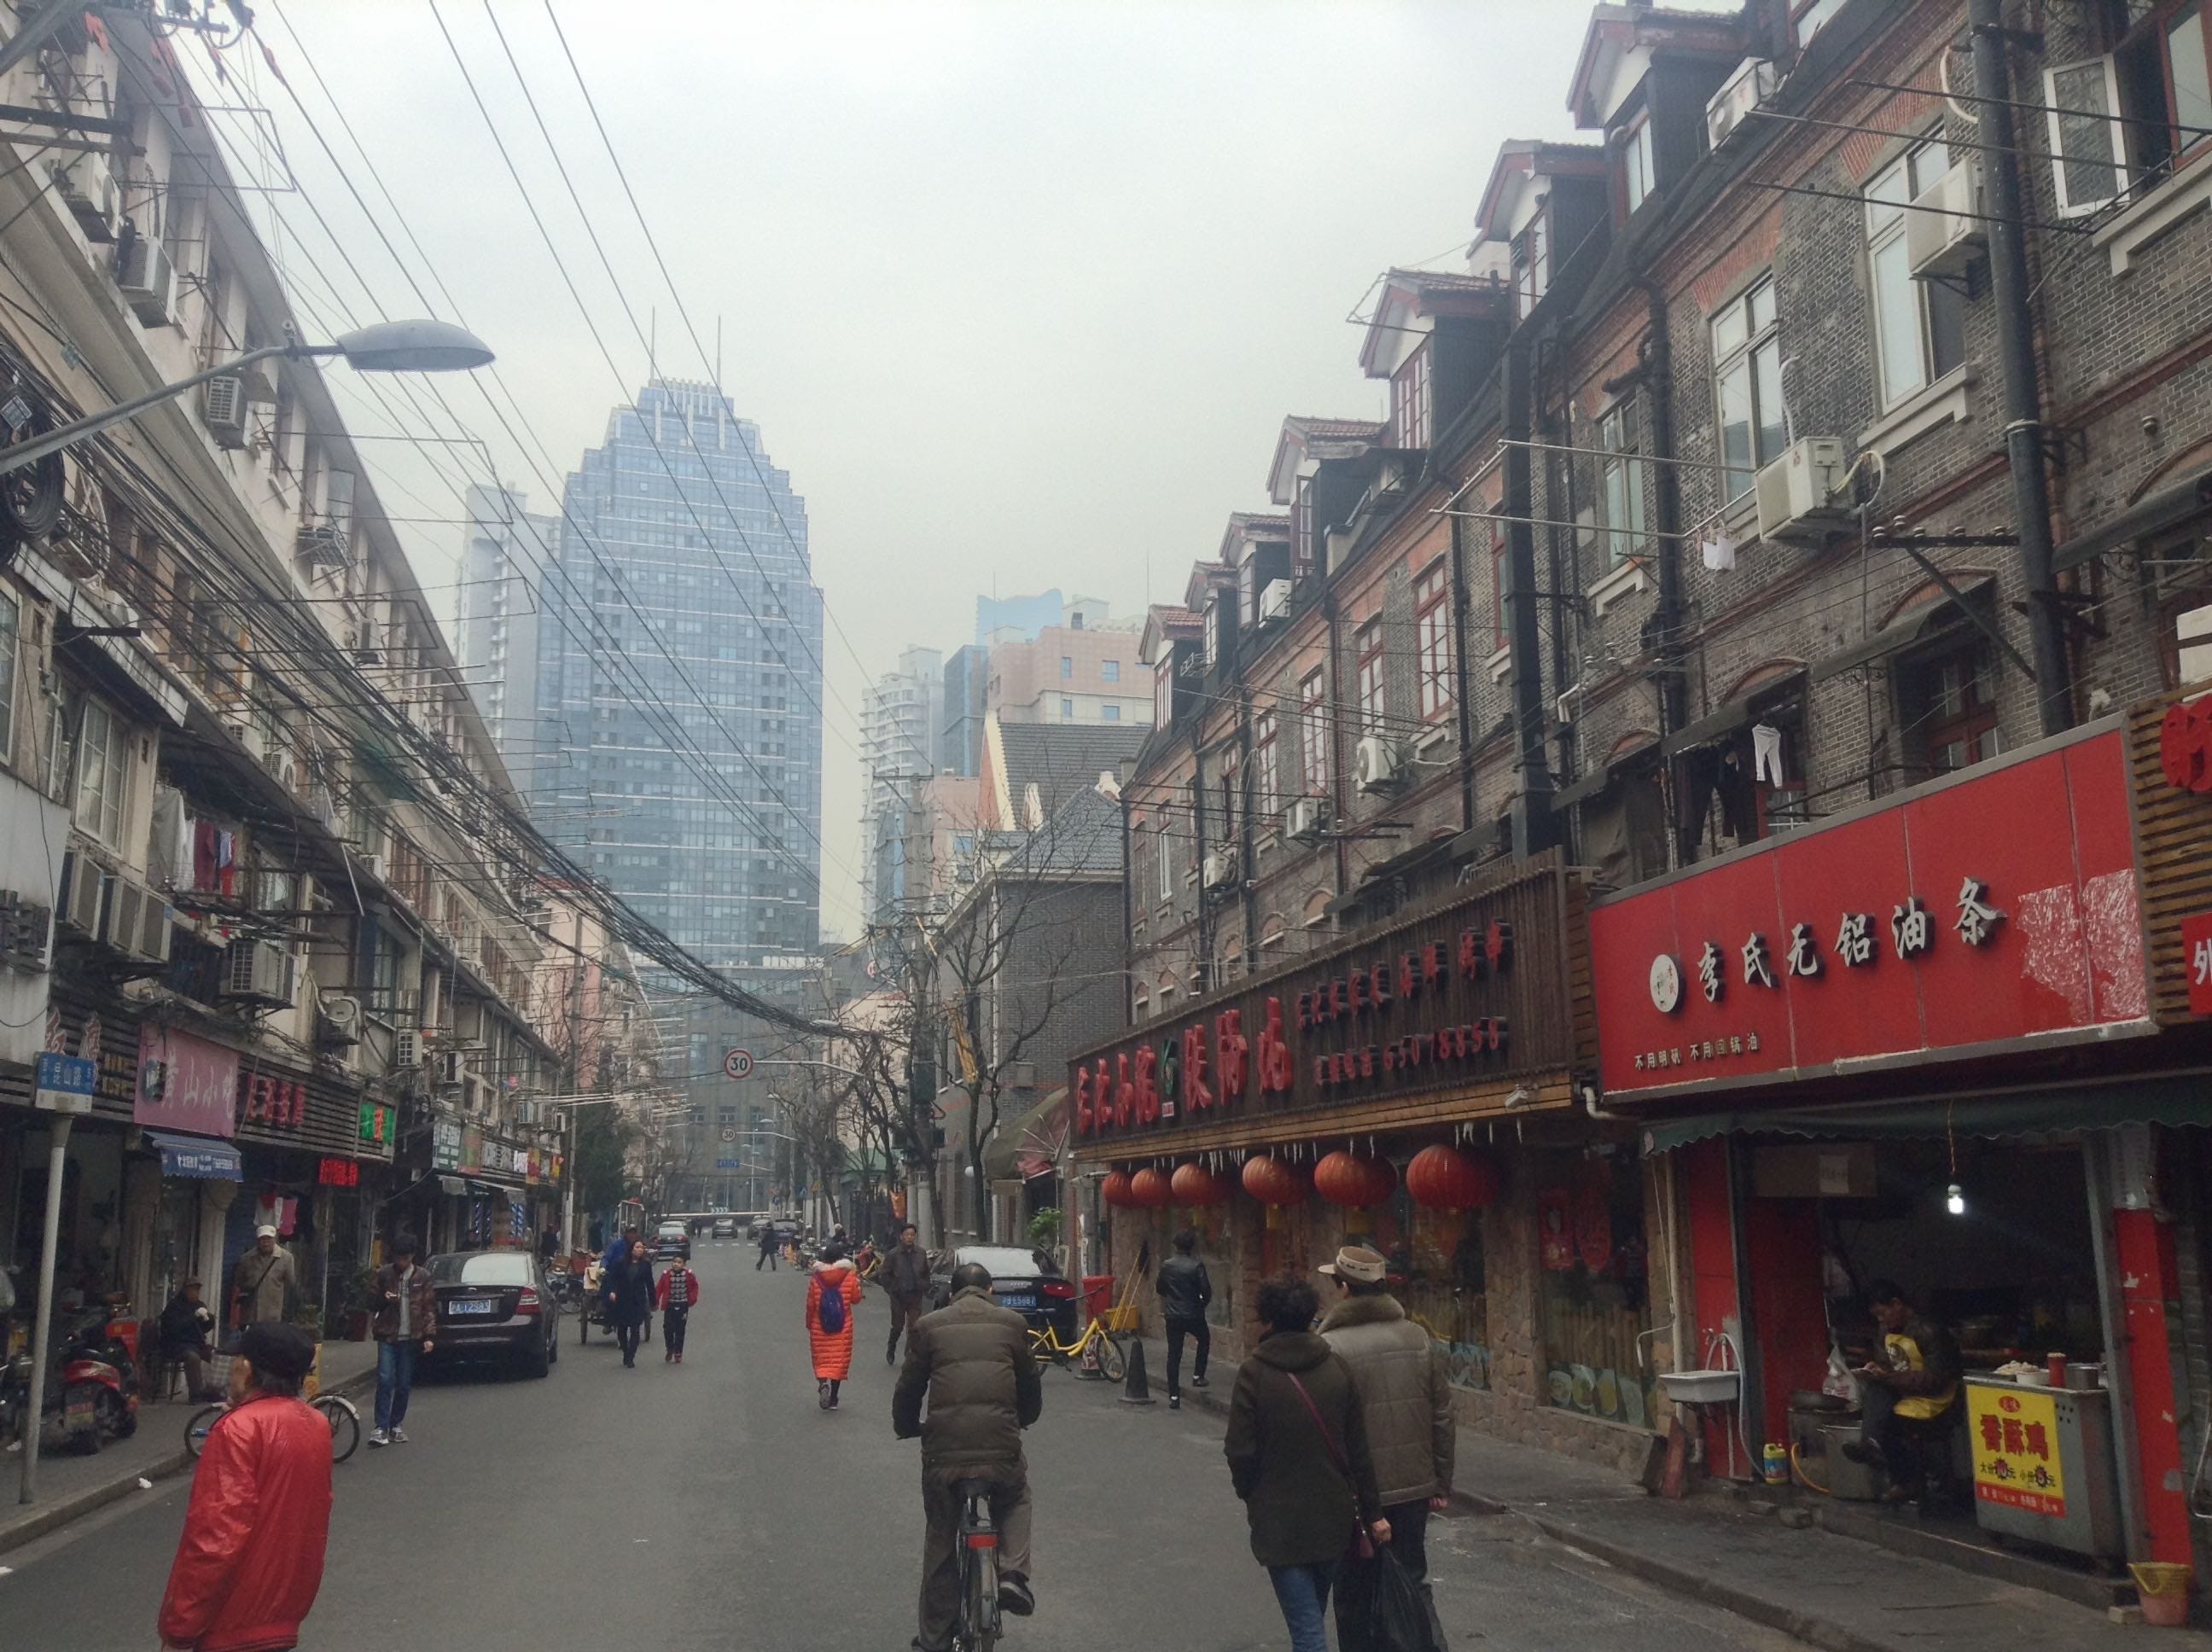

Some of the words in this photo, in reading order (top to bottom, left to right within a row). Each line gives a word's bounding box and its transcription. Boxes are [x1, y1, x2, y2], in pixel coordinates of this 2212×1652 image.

[1697, 876, 2005, 1003] 李氏无铝油条
[731, 1057, 748, 1071] 30
